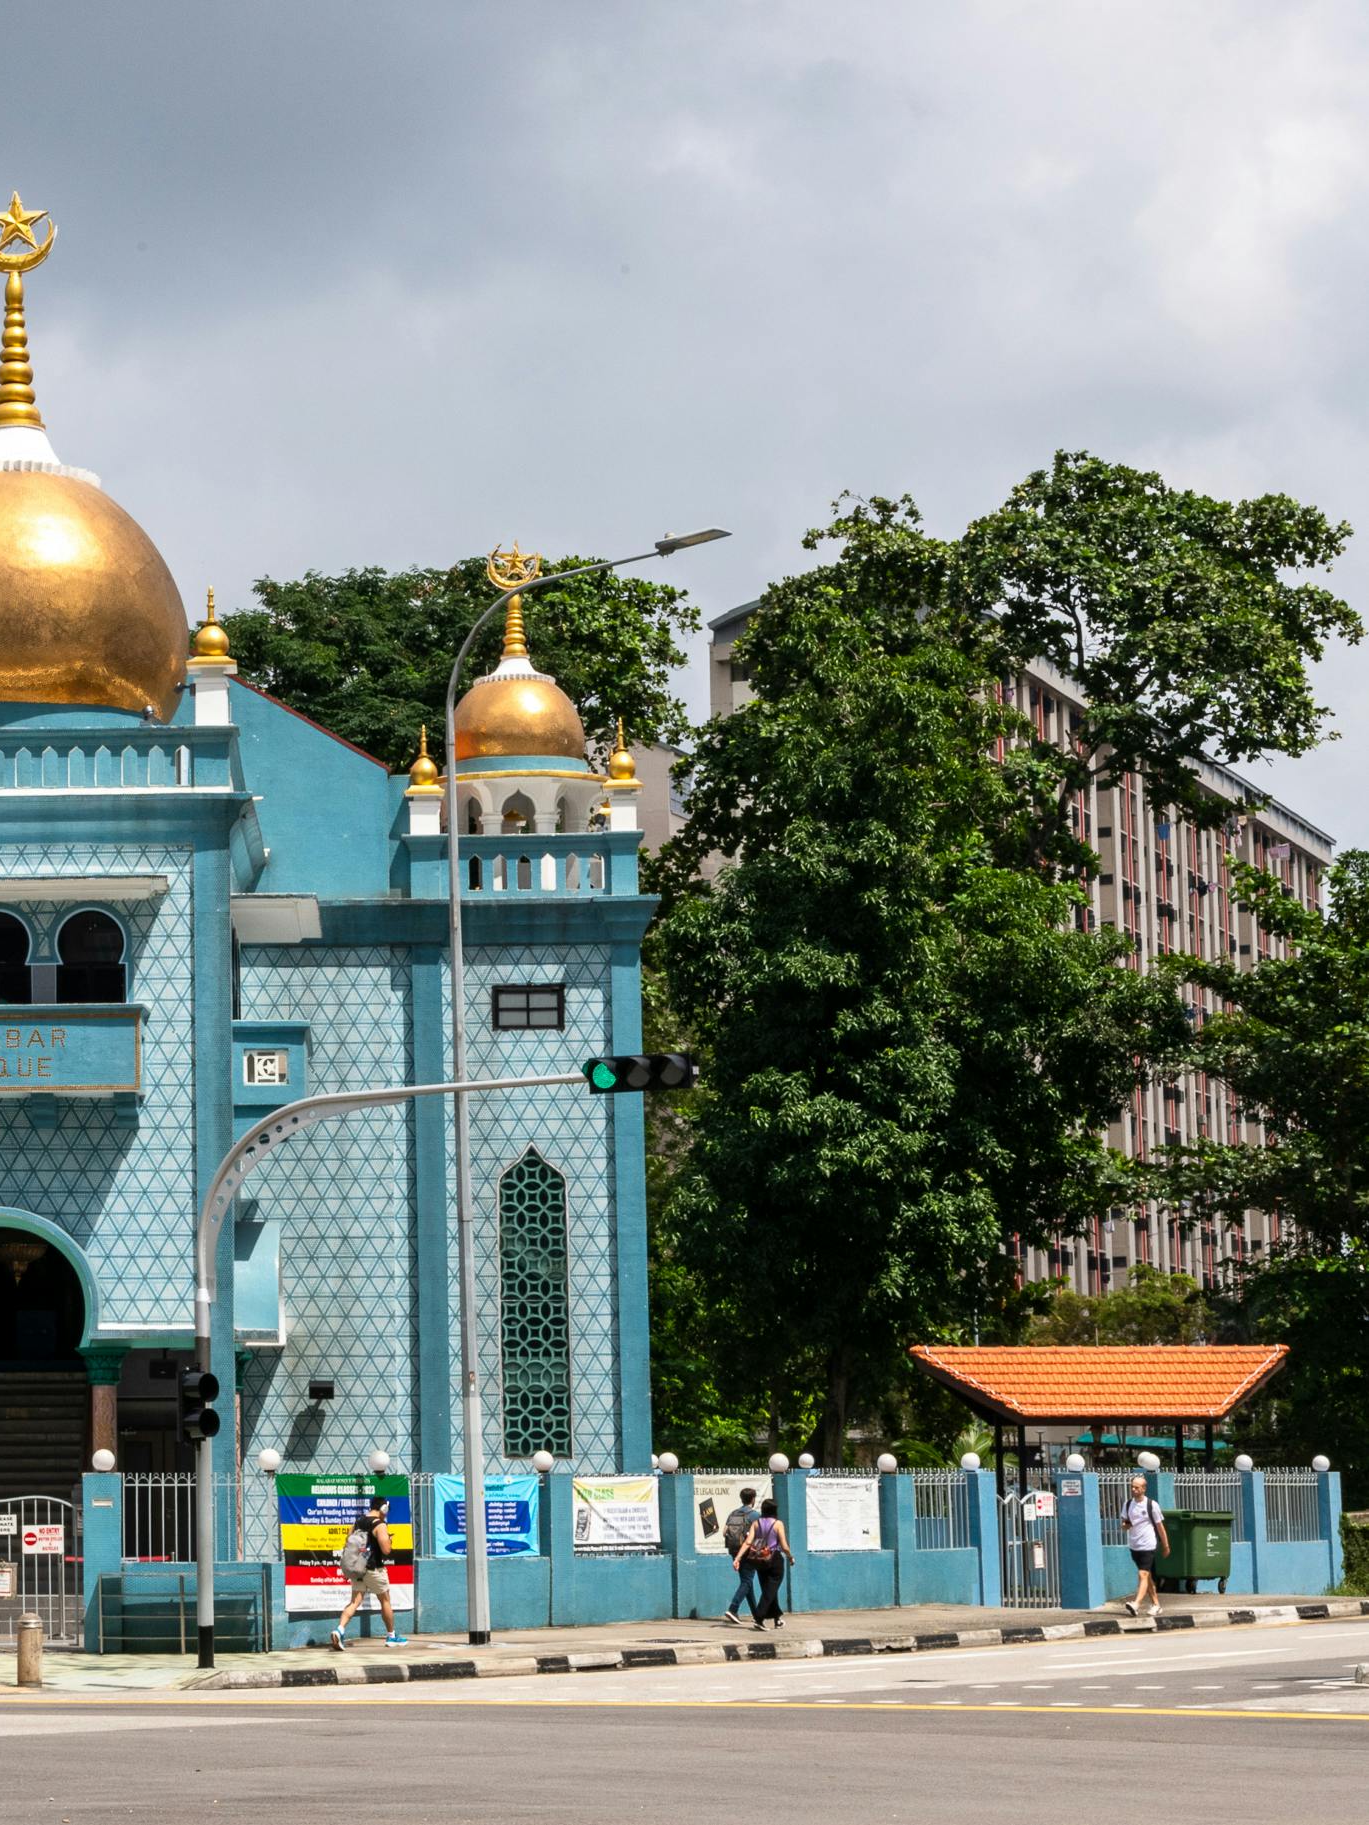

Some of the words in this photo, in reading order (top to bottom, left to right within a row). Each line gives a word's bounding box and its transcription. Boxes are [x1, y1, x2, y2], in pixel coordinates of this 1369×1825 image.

[700, 1487, 714, 1496] LEGAL
[323, 1508, 341, 1517] Reading
[325, 1516, 342, 1524] Sunday
